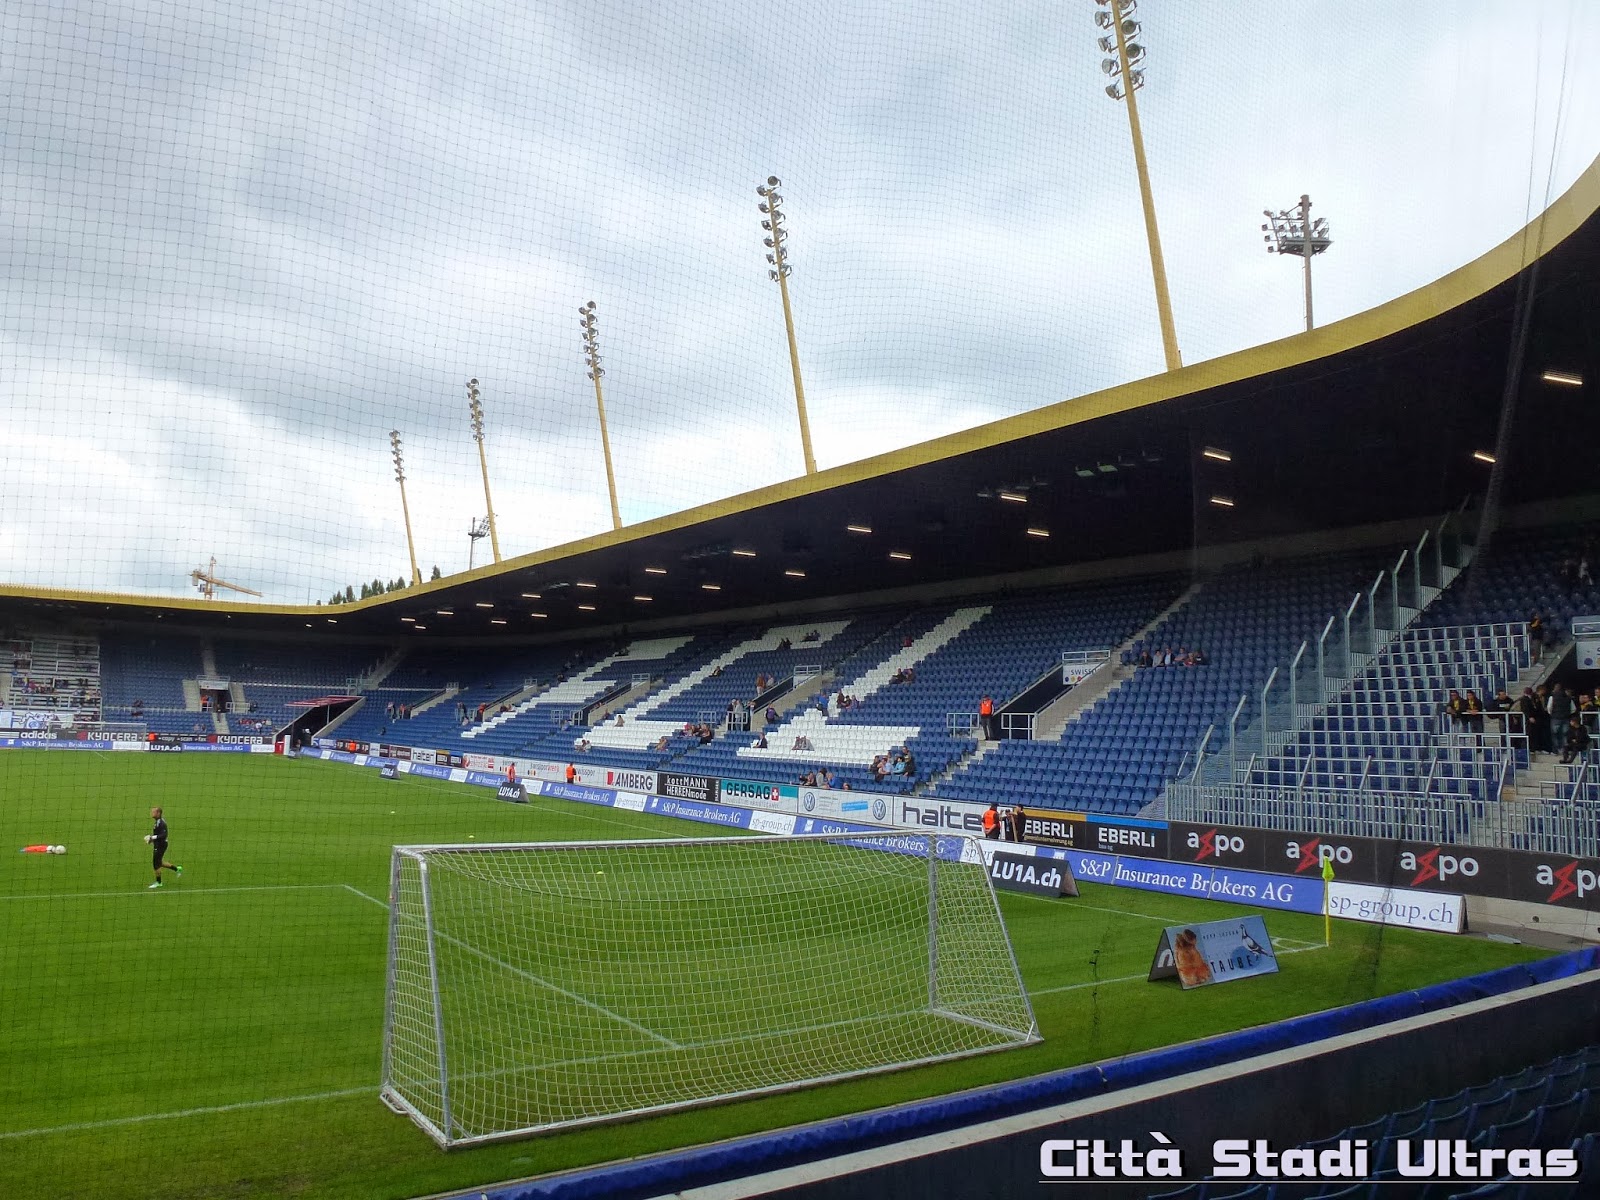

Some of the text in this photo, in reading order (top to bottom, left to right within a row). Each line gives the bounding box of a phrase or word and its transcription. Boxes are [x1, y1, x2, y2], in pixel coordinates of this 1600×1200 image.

[20, 730, 57, 740] adidas
[87, 731, 138, 742] KYOCERA
[217, 735, 263, 745] KYOCERA
[615, 772, 653, 790] AMBERG
[726, 782, 771, 800] GERSAG
[662, 802, 741, 824] S&P Insurance Brokers AG
[902, 801, 982, 832] halte
[1024, 819, 1073, 839] EBERLI
[1098, 827, 1155, 848] EBERLI
[992, 860, 1062, 889] LU1A.ch
[1078, 858, 1294, 903] S&P Insurance Brokers AG
[1536, 861, 1600, 903] axp
[1331, 895, 1454, 924] sp-group.ch
